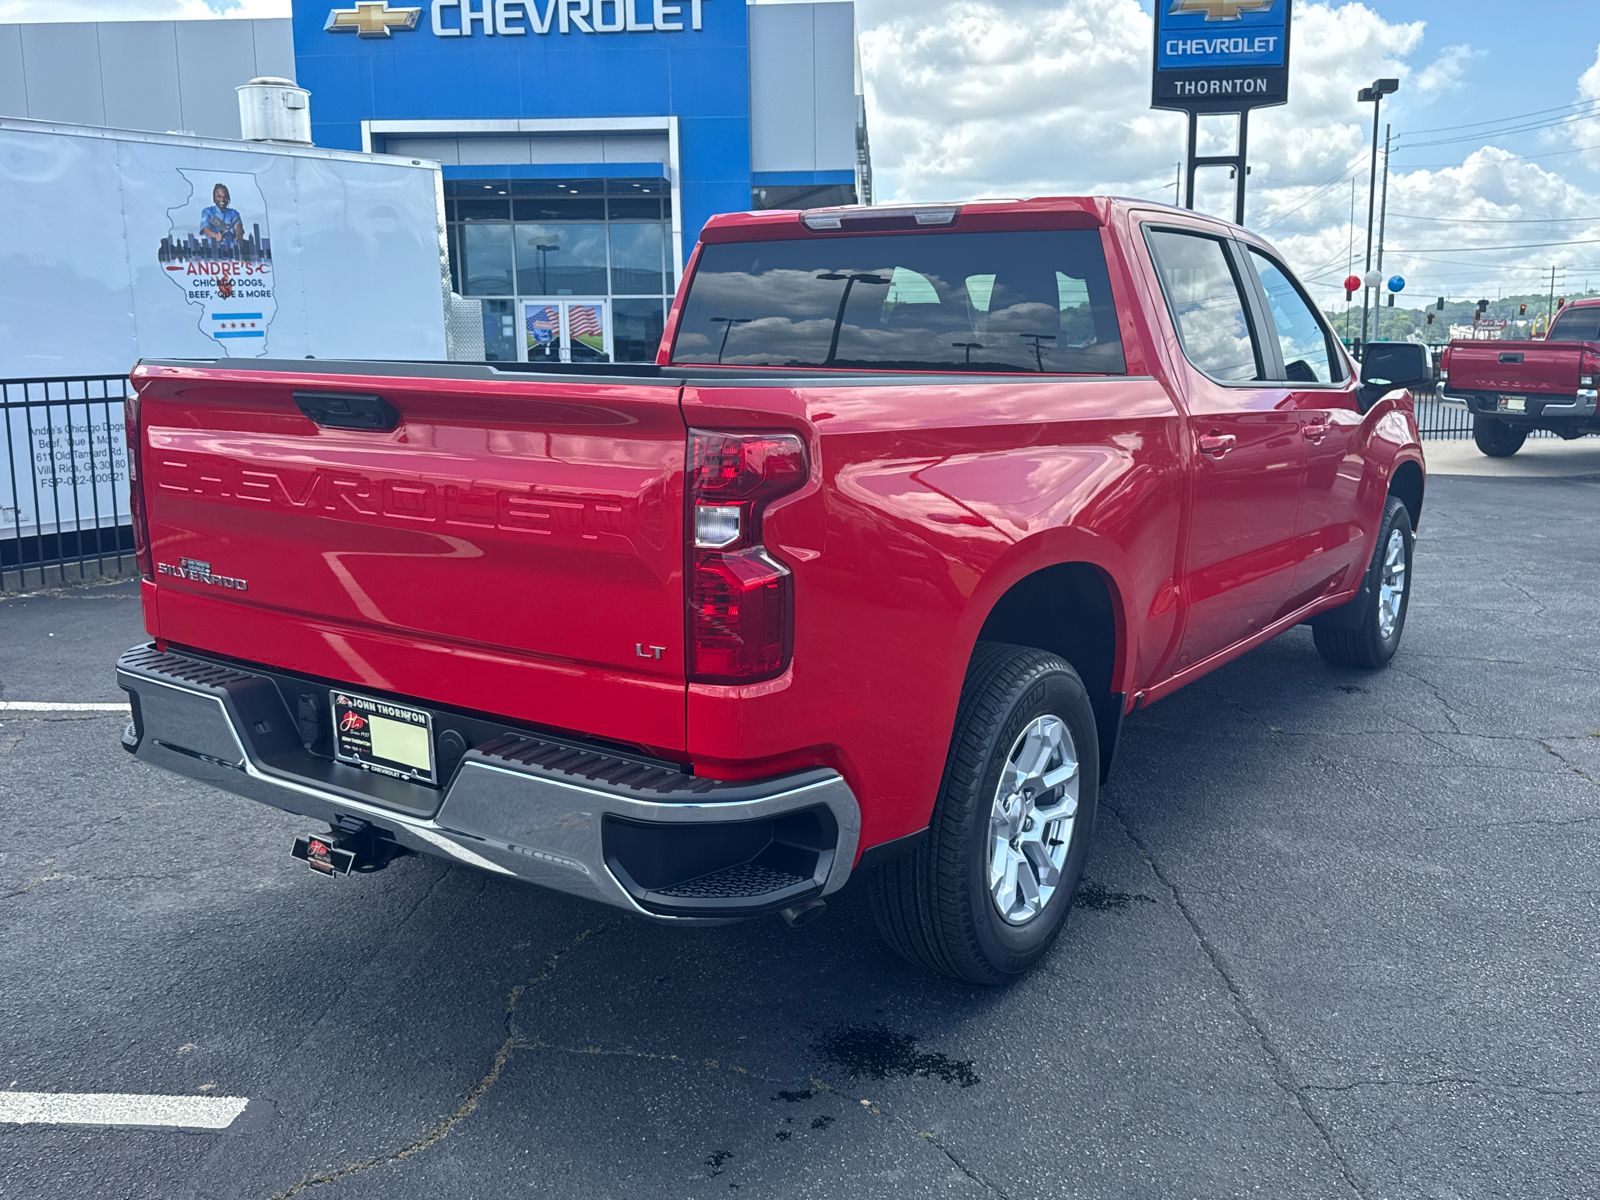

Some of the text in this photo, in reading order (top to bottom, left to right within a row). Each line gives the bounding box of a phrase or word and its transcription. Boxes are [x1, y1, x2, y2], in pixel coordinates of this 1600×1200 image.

[431, 0, 703, 36] CHEVROLET
[1166, 36, 1278, 55] CHEVROLET
[1174, 78, 1267, 95] THORNTON
[186, 261, 254, 276] ANDRE'S
[192, 278, 266, 288] CHICAGO DOGS,
[188, 290, 213, 300] BEEF,
[238, 290, 244, 298] &
[246, 289, 272, 298] MORE
[65, 423, 100, 434] Chicago
[38, 438, 63, 449] Beef,
[97, 434, 119, 445] More
[55, 450, 71, 461] Old
[37, 465, 54, 475] Vill
[99, 459, 126, 471] 3080
[159, 456, 621, 539] CHEVROLET
[157, 562, 248, 590] SILVERADO
[635, 643, 668, 659] LT
[352, 698, 426, 724] JOHN THORNTON
